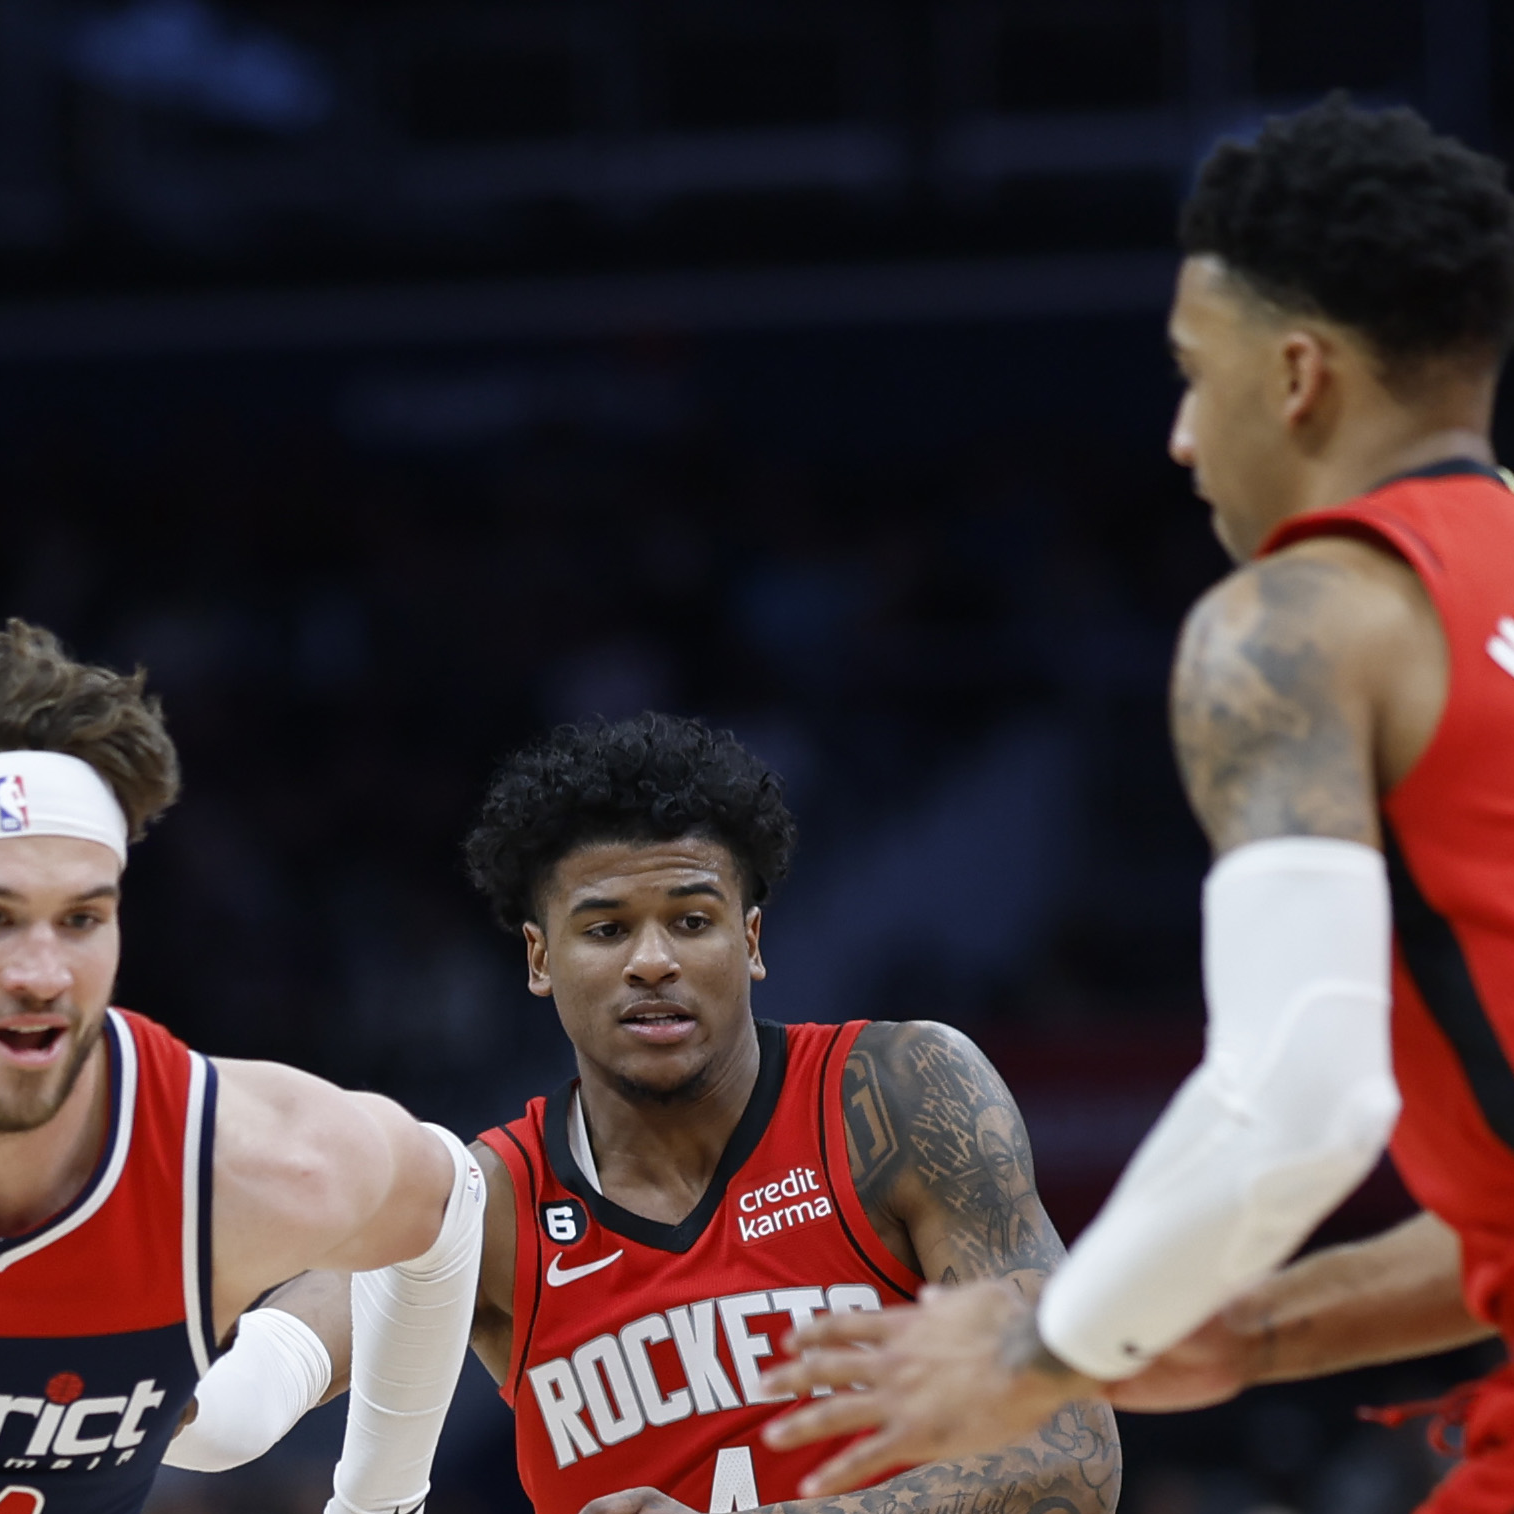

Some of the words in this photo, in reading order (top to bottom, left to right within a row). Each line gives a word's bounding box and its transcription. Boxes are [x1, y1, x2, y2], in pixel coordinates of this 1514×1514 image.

[739, 1166, 820, 1213] credit
[545, 1205, 577, 1241] 6
[737, 1195, 832, 1243] karma
